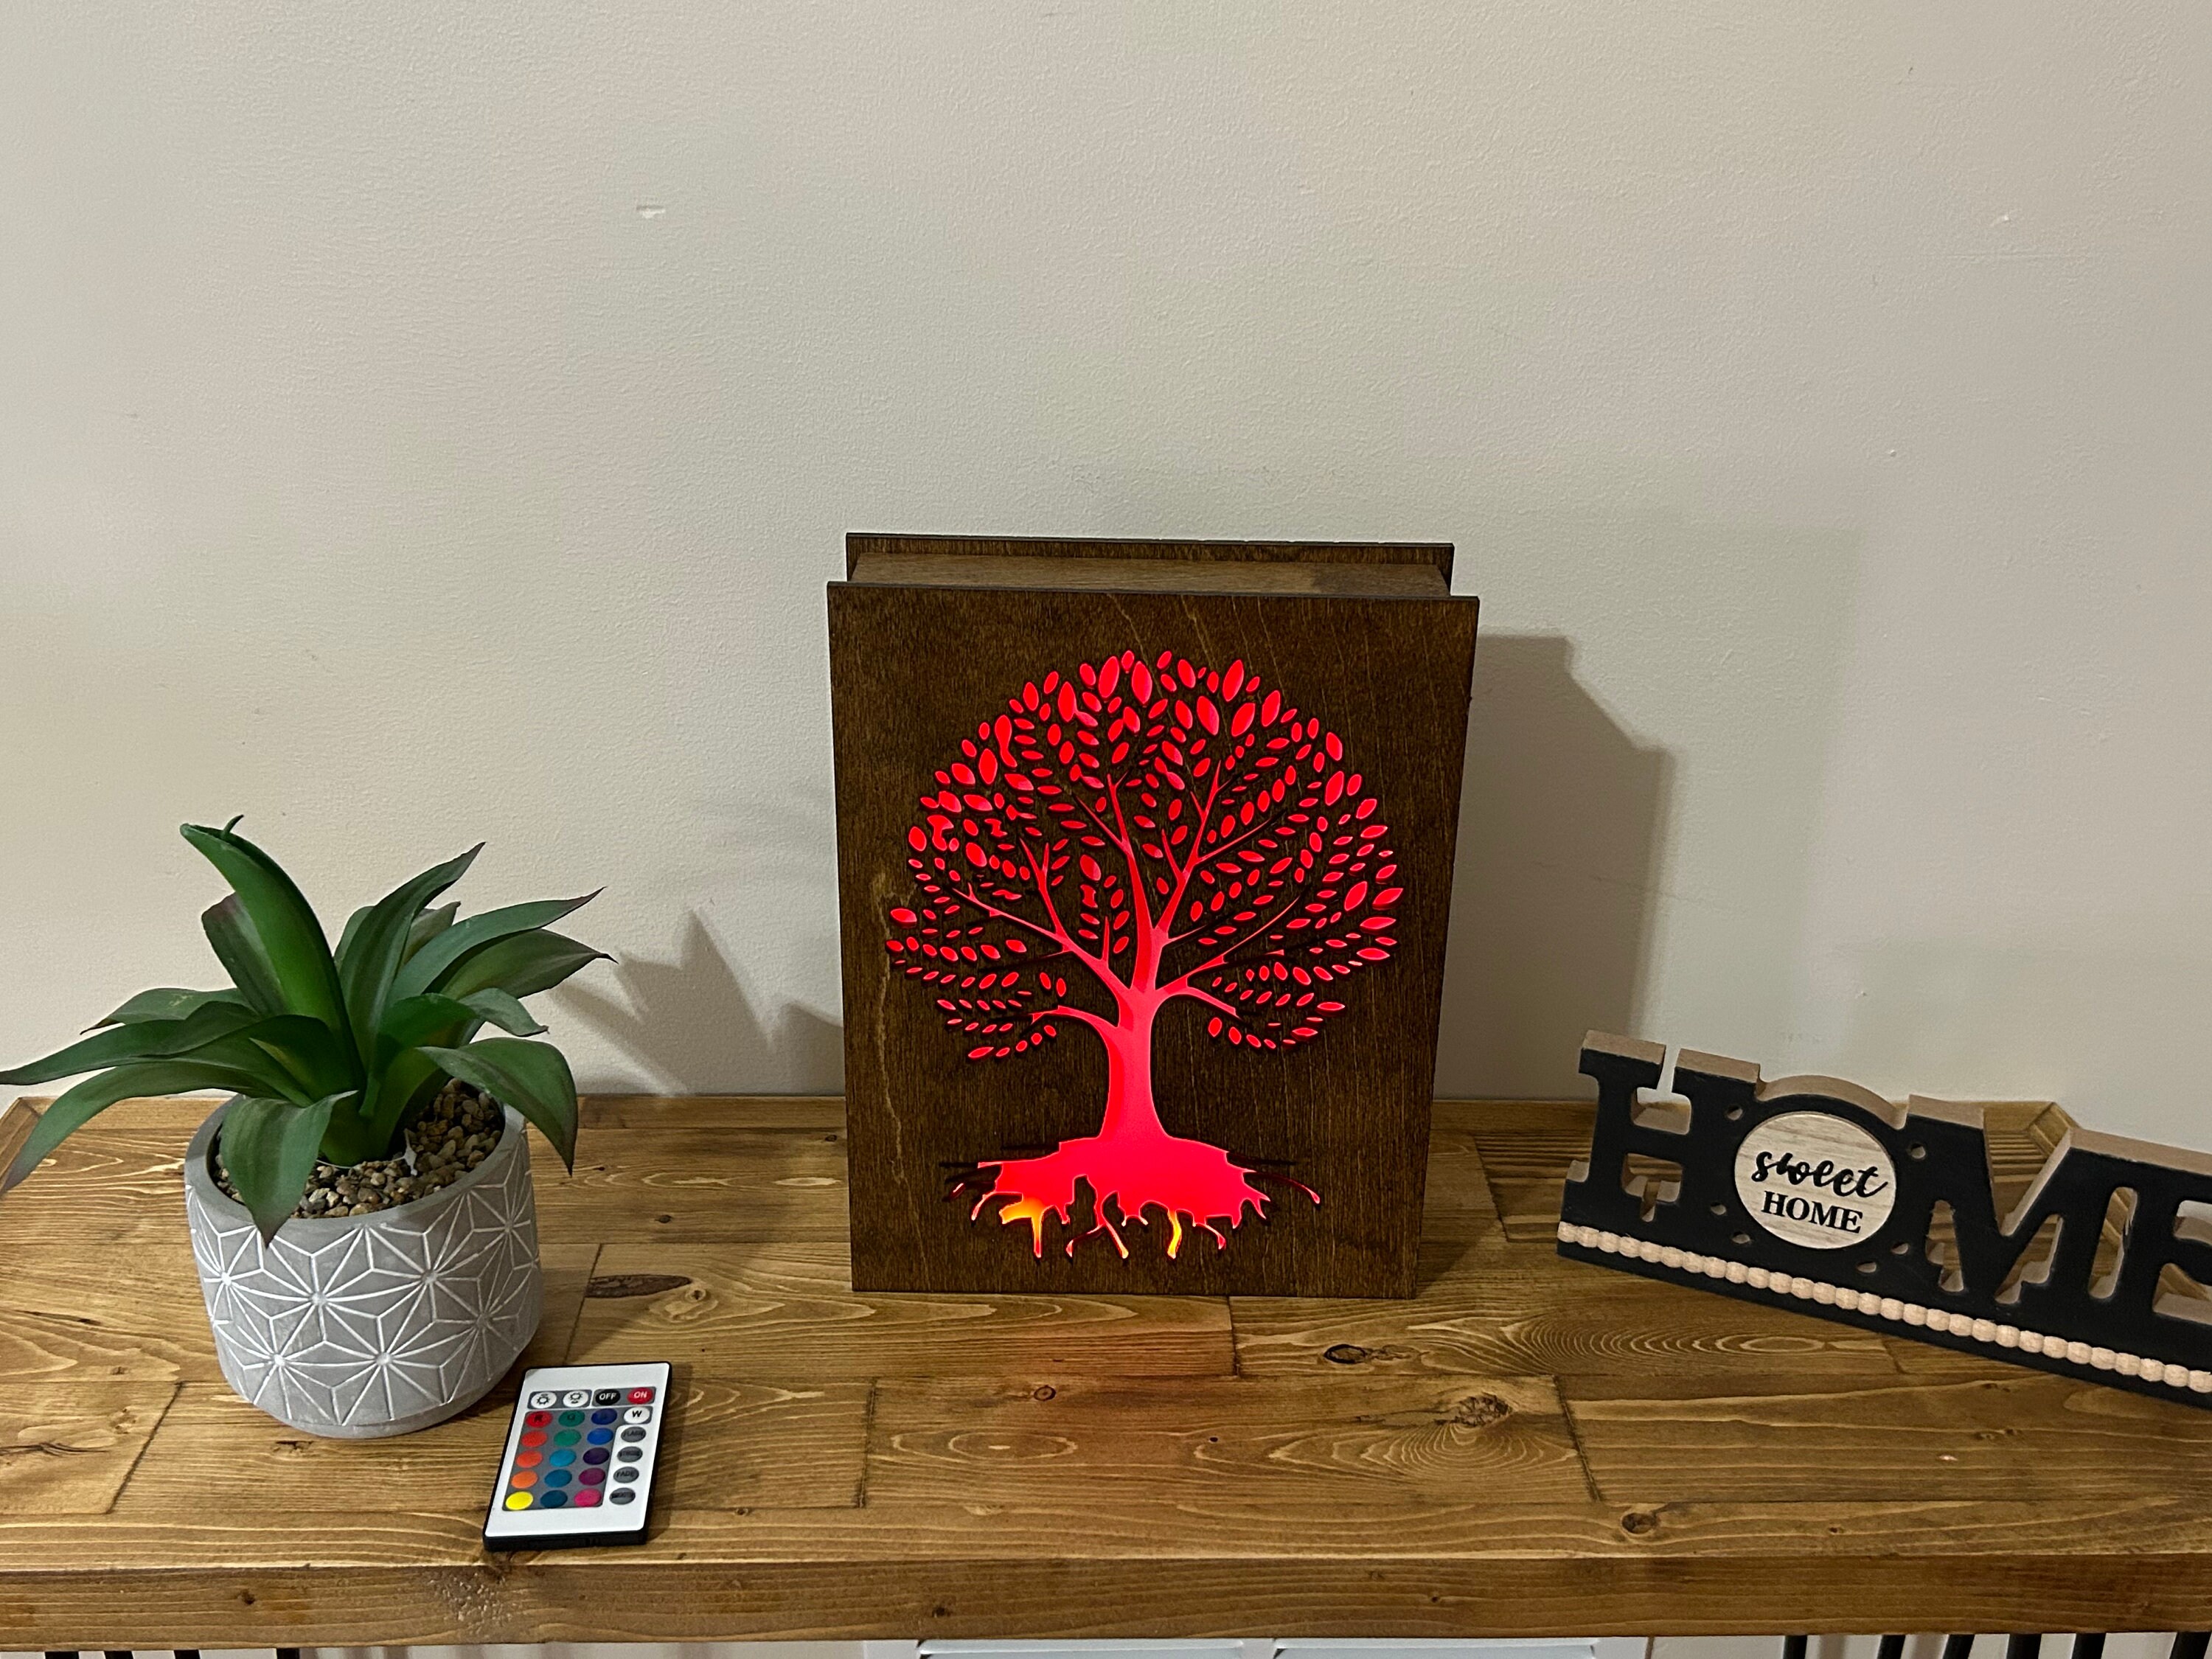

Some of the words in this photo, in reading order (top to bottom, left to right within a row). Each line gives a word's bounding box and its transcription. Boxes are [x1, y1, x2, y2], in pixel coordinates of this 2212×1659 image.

[1751, 1151, 1888, 1198] sweet
[1761, 1191, 1863, 1234] HOME
[599, 1392, 617, 1401] OFF
[633, 1391, 647, 1399] ON
[632, 1410, 642, 1418] W
